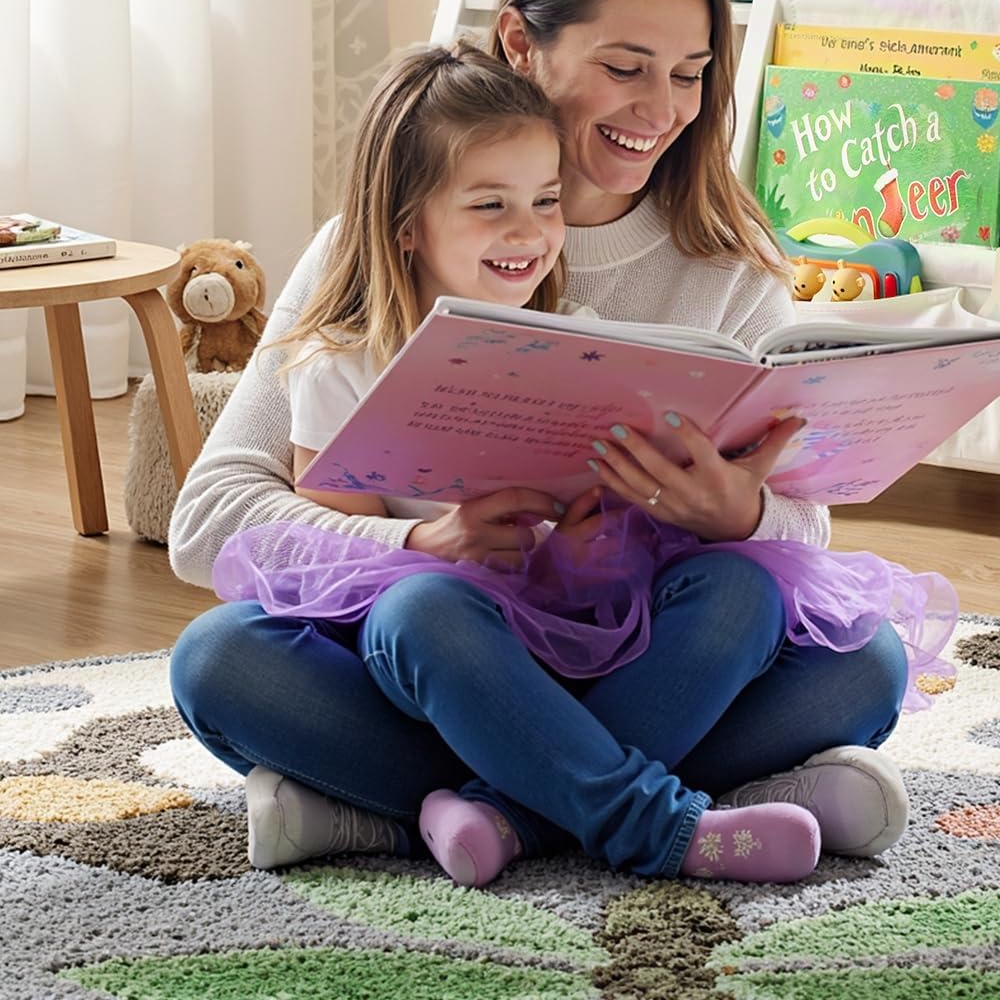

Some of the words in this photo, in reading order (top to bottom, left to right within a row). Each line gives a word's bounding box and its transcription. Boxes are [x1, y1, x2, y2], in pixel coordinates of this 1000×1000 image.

[790, 99, 854, 162] How
[805, 166, 838, 202] to
[841, 103, 917, 179] Catch
[926, 111, 942, 144] a
